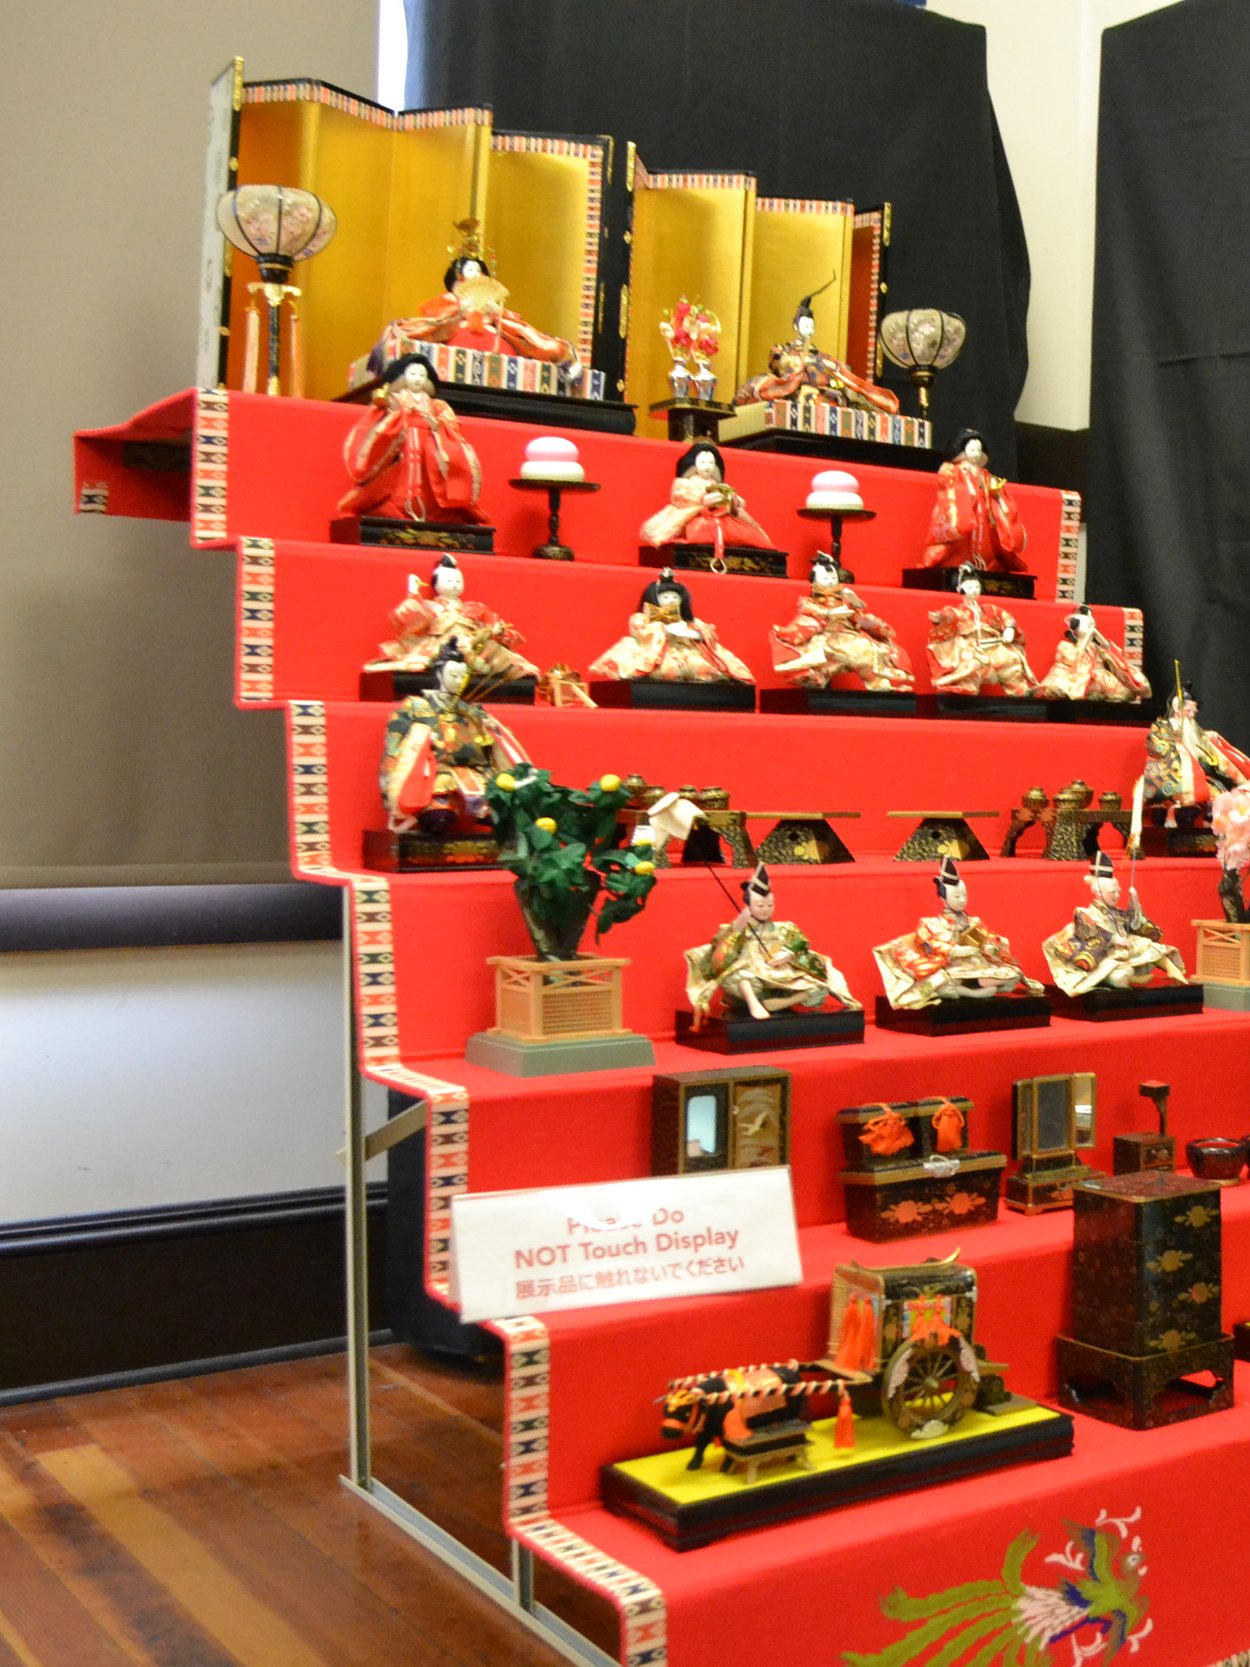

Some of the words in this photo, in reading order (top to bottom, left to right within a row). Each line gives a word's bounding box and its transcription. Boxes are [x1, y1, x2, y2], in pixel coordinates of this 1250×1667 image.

[652, 1207, 685, 1226] Do
[514, 1244, 571, 1269] NOT
[578, 1235, 648, 1261] Touch
[656, 1227, 739, 1252] Display
[515, 1256, 745, 1300] 展示品に触れないでください
